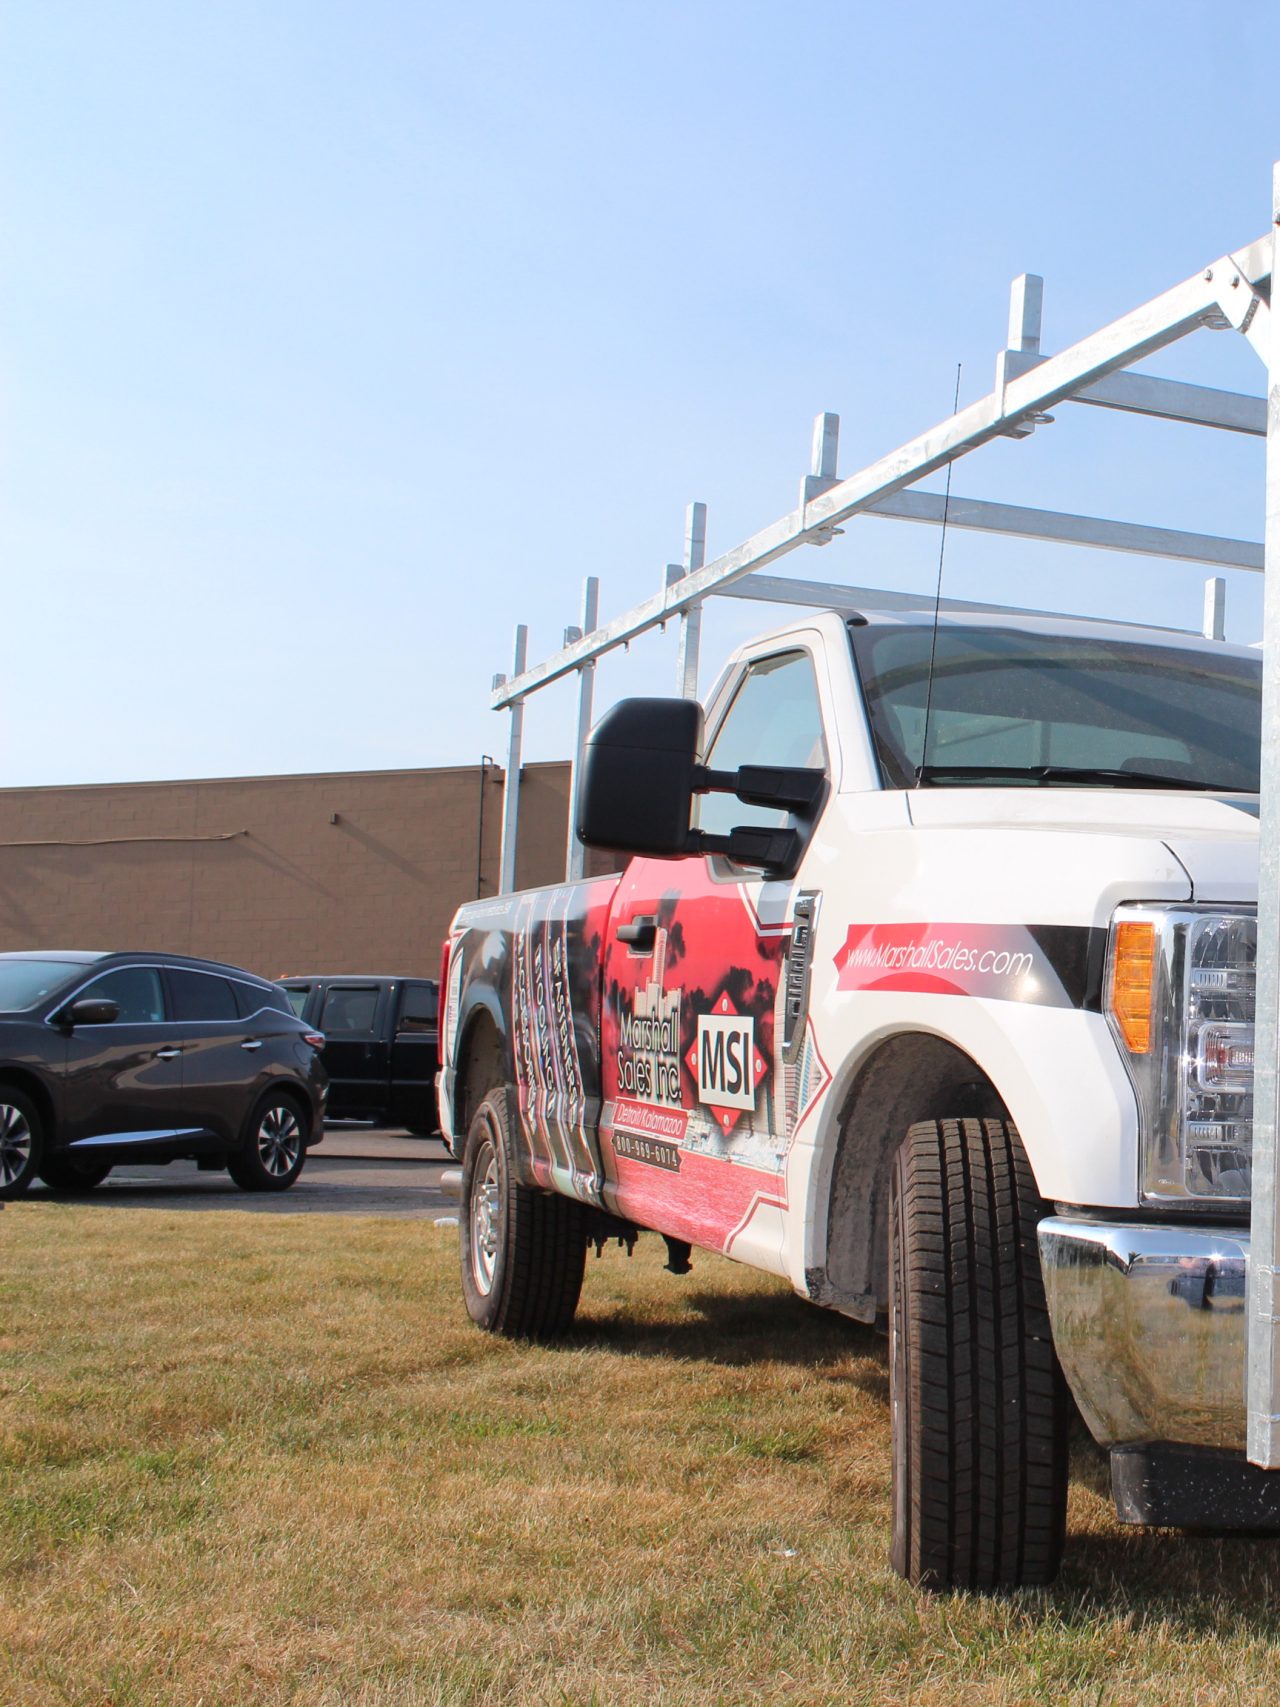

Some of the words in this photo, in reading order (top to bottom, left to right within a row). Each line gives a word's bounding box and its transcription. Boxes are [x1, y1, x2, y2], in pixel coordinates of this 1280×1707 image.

[845, 939, 1033, 976] www.MarshallSales.com
[536, 966, 554, 1090] TOOLING
[554, 963, 578, 1105] FASTENERS
[619, 1010, 679, 1053] Marshall
[617, 1051, 651, 1094] Sales
[655, 1054, 682, 1099] Inc.
[702, 1029, 750, 1096] MSI
[617, 1103, 683, 1135] Detroit/Kalamazoo
[616, 1135, 678, 1167] 800-969-6074
